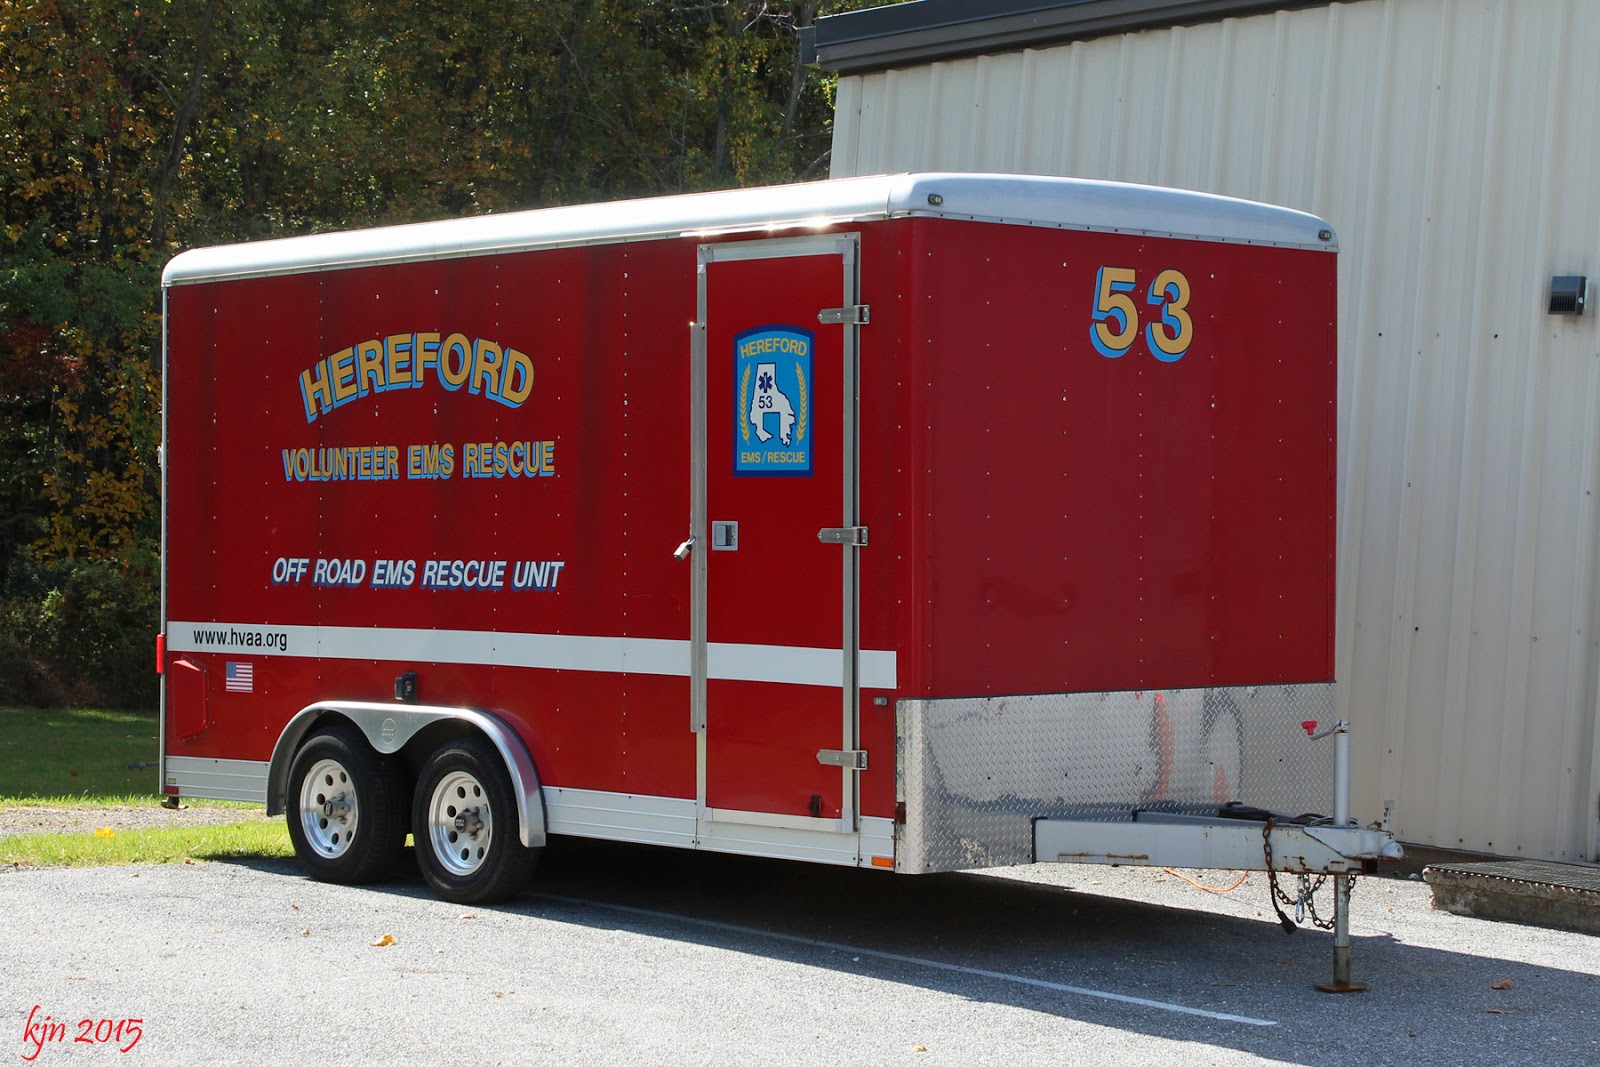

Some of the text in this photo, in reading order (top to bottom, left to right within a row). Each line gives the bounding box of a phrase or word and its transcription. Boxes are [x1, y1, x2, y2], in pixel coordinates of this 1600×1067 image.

[1089, 265, 1193, 363] 53
[740, 338, 808, 359] HEREFORD
[300, 332, 535, 424] HEREFORD
[758, 395, 773, 409] 53
[282, 440, 555, 482] VOLUNTEER EMS RESCUE
[271, 557, 565, 590] OFF ROAD EMS RESCUE UNIT
[193, 627, 287, 652] www.hvaa.org
